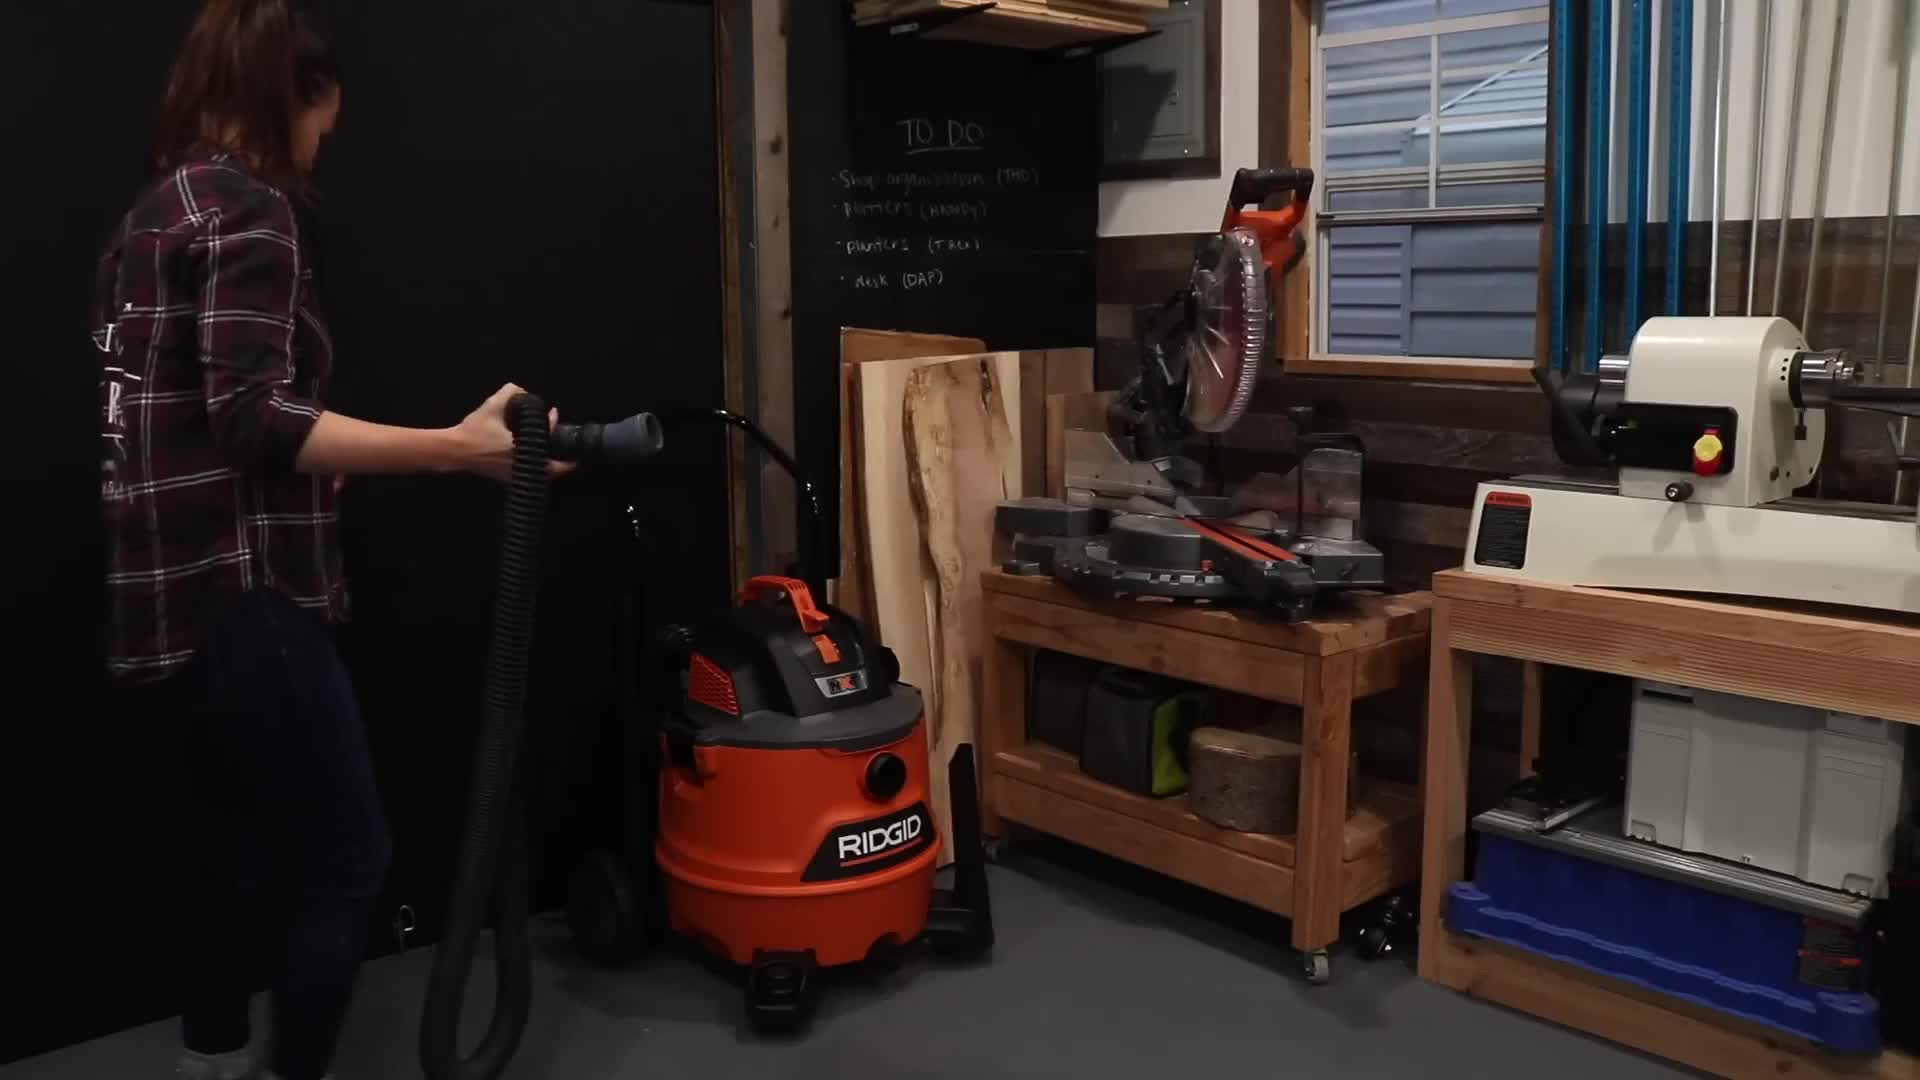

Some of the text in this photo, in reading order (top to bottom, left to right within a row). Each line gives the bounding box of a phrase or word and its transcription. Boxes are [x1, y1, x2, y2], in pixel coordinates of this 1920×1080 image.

[896, 118, 985, 147] TO DO
[902, 267, 943, 290] (DAP)
[838, 814, 922, 860] RIDGID
